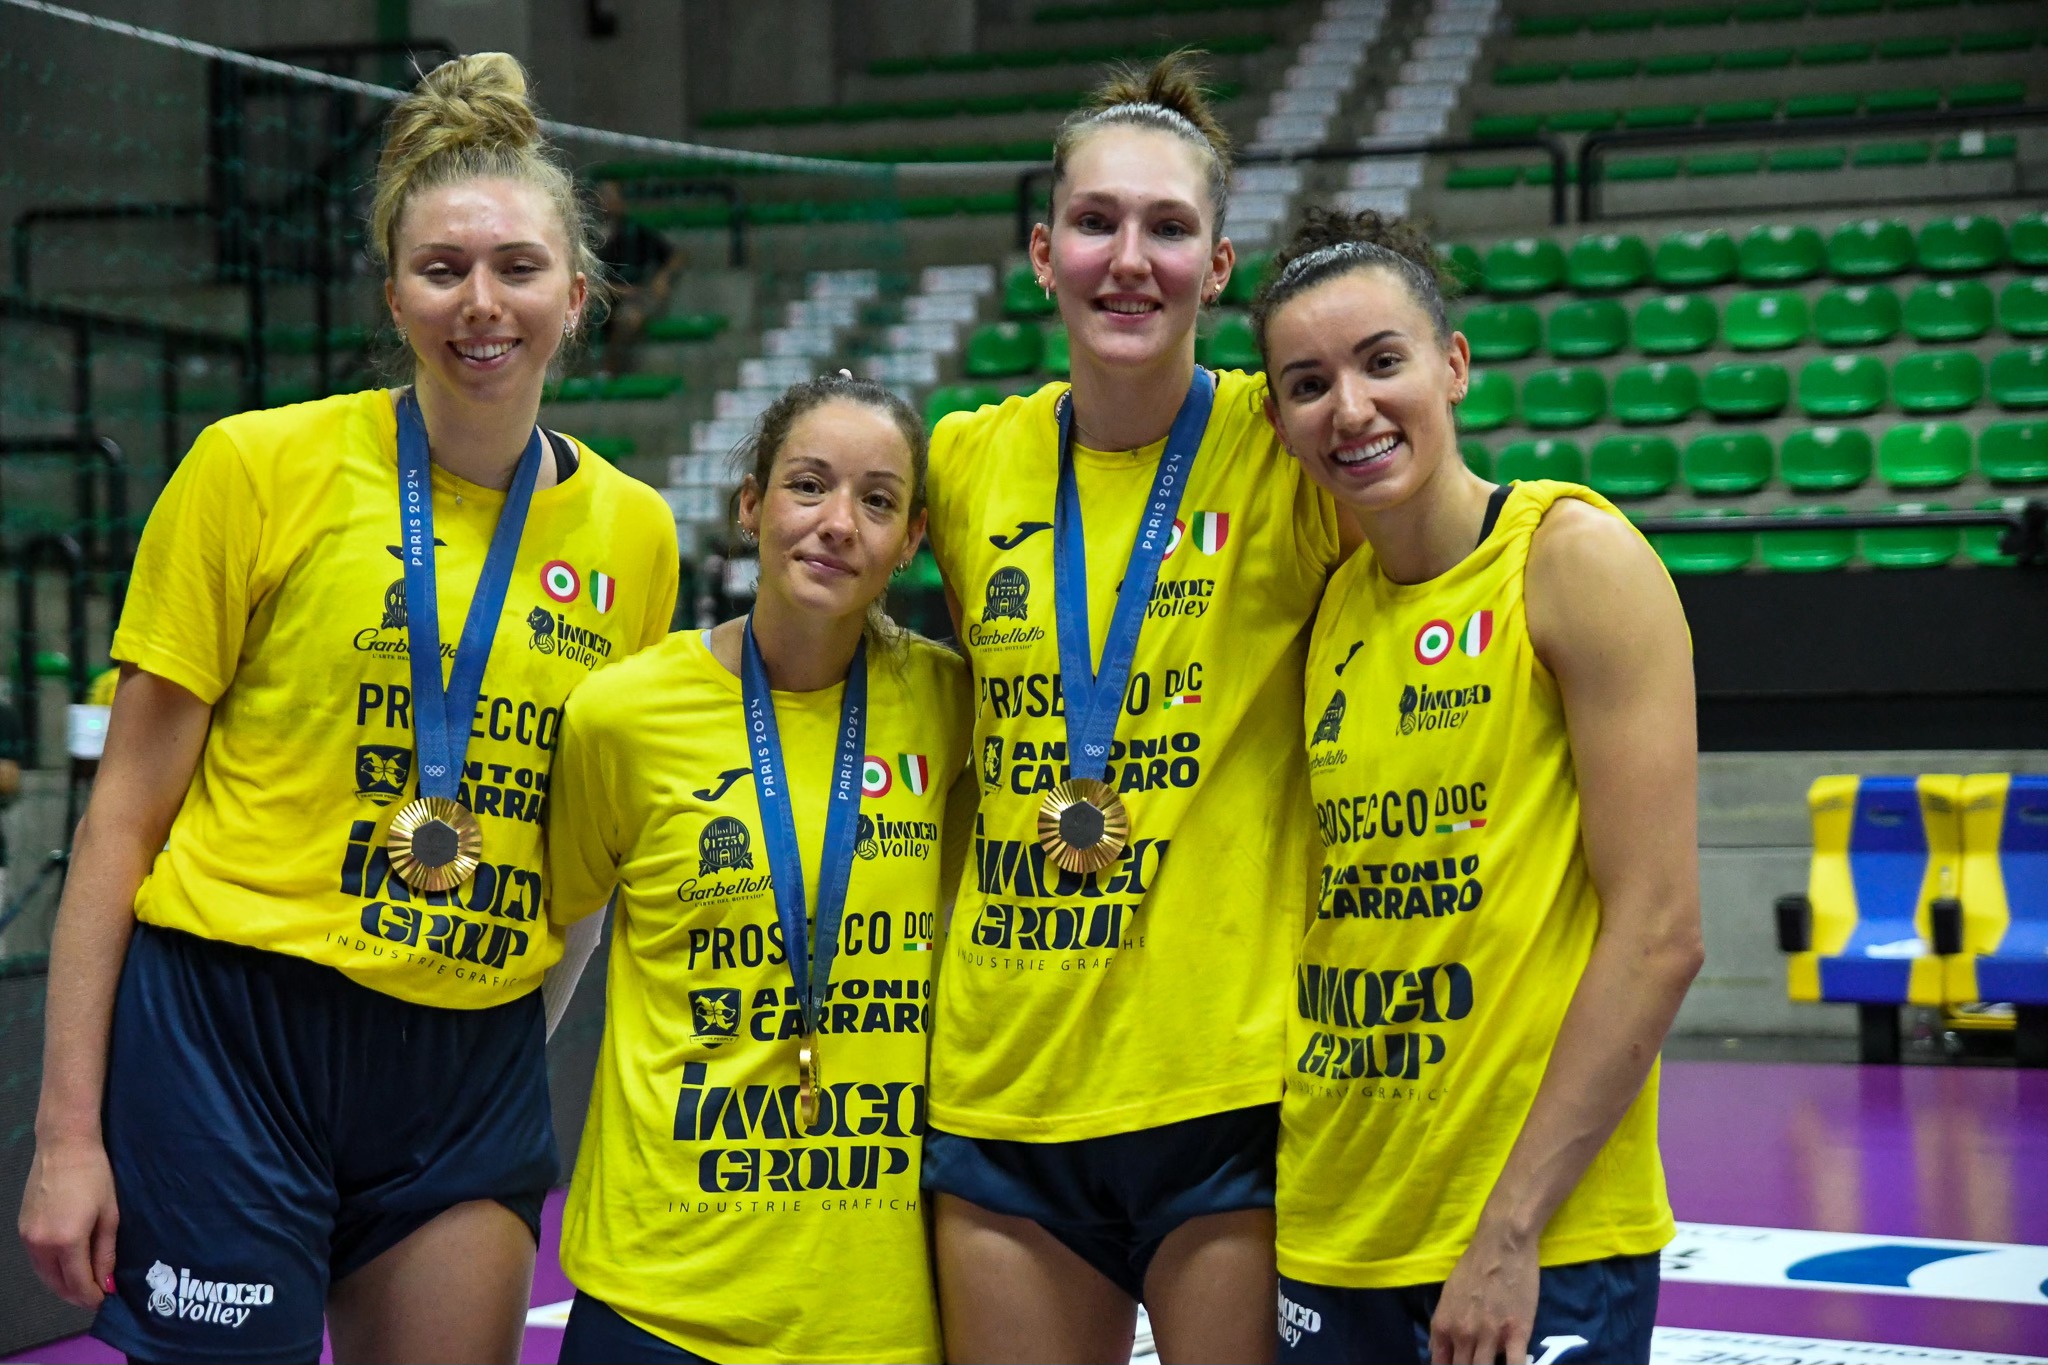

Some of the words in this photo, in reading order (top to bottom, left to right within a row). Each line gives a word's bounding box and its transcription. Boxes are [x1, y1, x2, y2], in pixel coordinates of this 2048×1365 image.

[406, 468, 420, 514] 2024
[1142, 501, 1167, 551] PARIS
[1158, 453, 1182, 497] 2024
[410, 515, 424, 567] PARIS
[1148, 599, 1209, 619] Volley
[557, 639, 598, 671] Volley
[969, 623, 1045, 647] Garbellotto
[356, 683, 558, 751] PRECCO
[978, 672, 1151, 718] PROSEO
[751, 698, 768, 743] 2024
[845, 705, 859, 749] 2024
[1417, 710, 1469, 732] Volley
[1012, 732, 1200, 761] ANONIO
[758, 747, 776, 798] PARIS
[838, 753, 854, 801] PARIS
[1011, 756, 1200, 795] CAARO
[1316, 787, 1429, 848] ROSECCO
[1434, 782, 1487, 817] DOC
[880, 839, 930, 861] Volley
[360, 901, 529, 969] GROUP
[687, 911, 891, 971] PROSCO
[325, 932, 447, 975] INDUSTRIE
[455, 967, 520, 988] GRAFIC
[957, 948, 1045, 971] INDUSTRIE
[698, 1145, 910, 1193] GROUP
[668, 1200, 801, 1213] INDUSTRIE
[822, 1198, 918, 1212] GRAFICH
[178, 1298, 250, 1328] Volley
